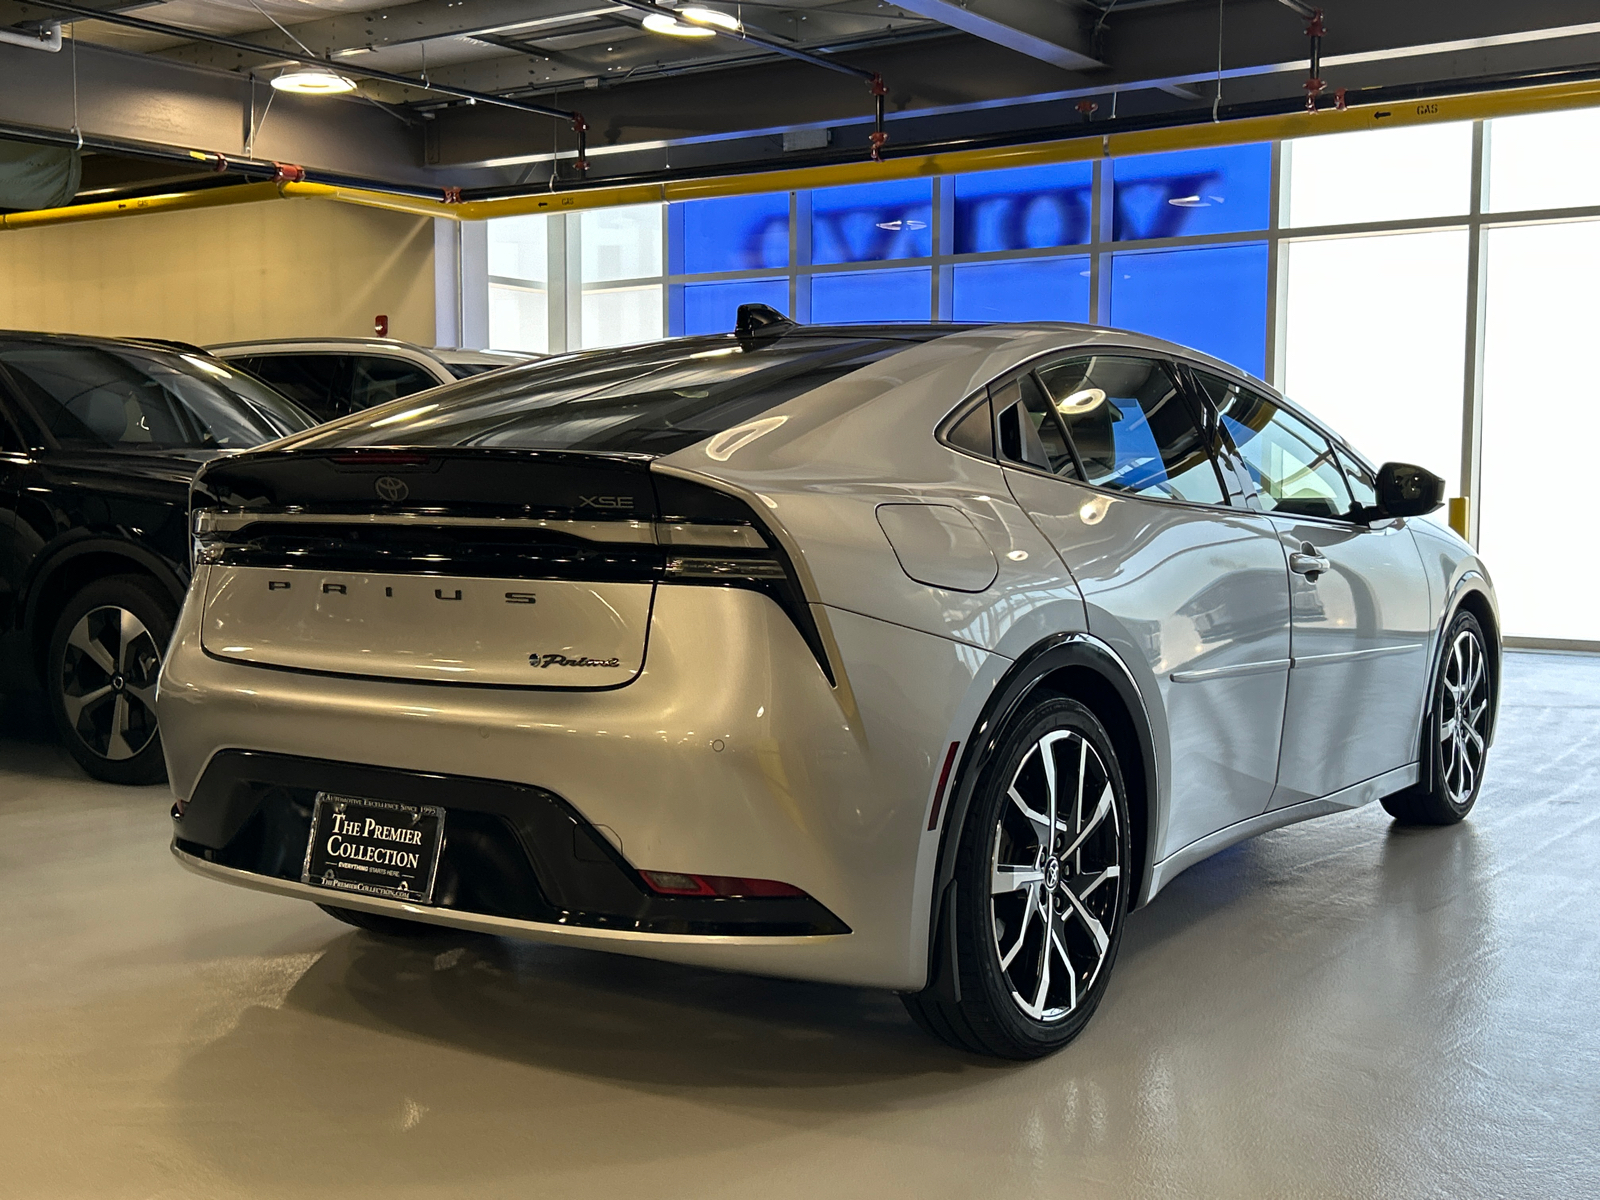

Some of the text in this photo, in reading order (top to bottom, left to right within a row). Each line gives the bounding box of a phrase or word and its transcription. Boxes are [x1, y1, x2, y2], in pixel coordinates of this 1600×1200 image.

[1416, 104, 1438, 115] GAS
[561, 197, 574, 206] GAS
[579, 495, 634, 509] XSE
[269, 580, 536, 604] PRIUS
